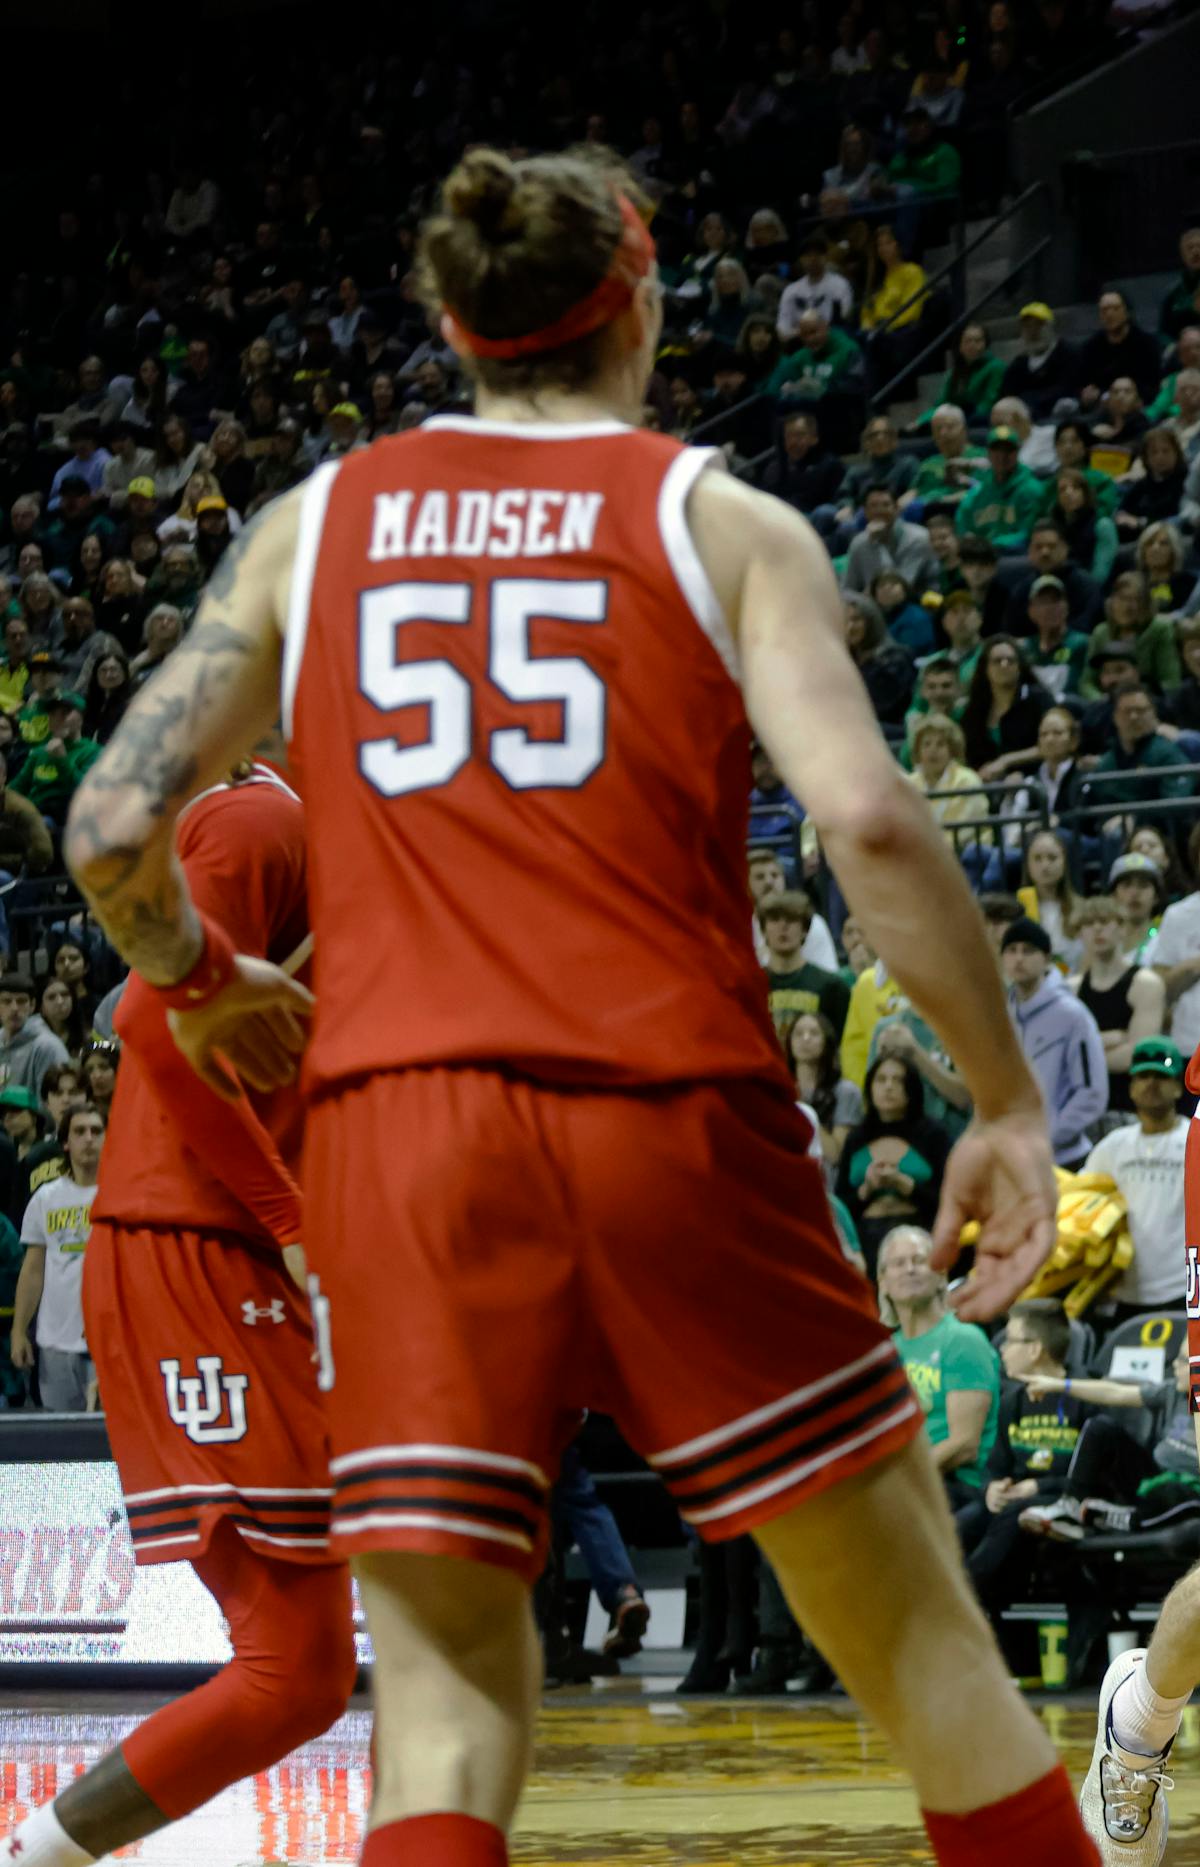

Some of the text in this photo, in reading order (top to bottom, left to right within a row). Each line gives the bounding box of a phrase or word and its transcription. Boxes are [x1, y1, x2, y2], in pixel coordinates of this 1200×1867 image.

[368, 488, 604, 563] MADSEN
[358, 577, 607, 798] 55
[1140, 1318, 1173, 1347] O
